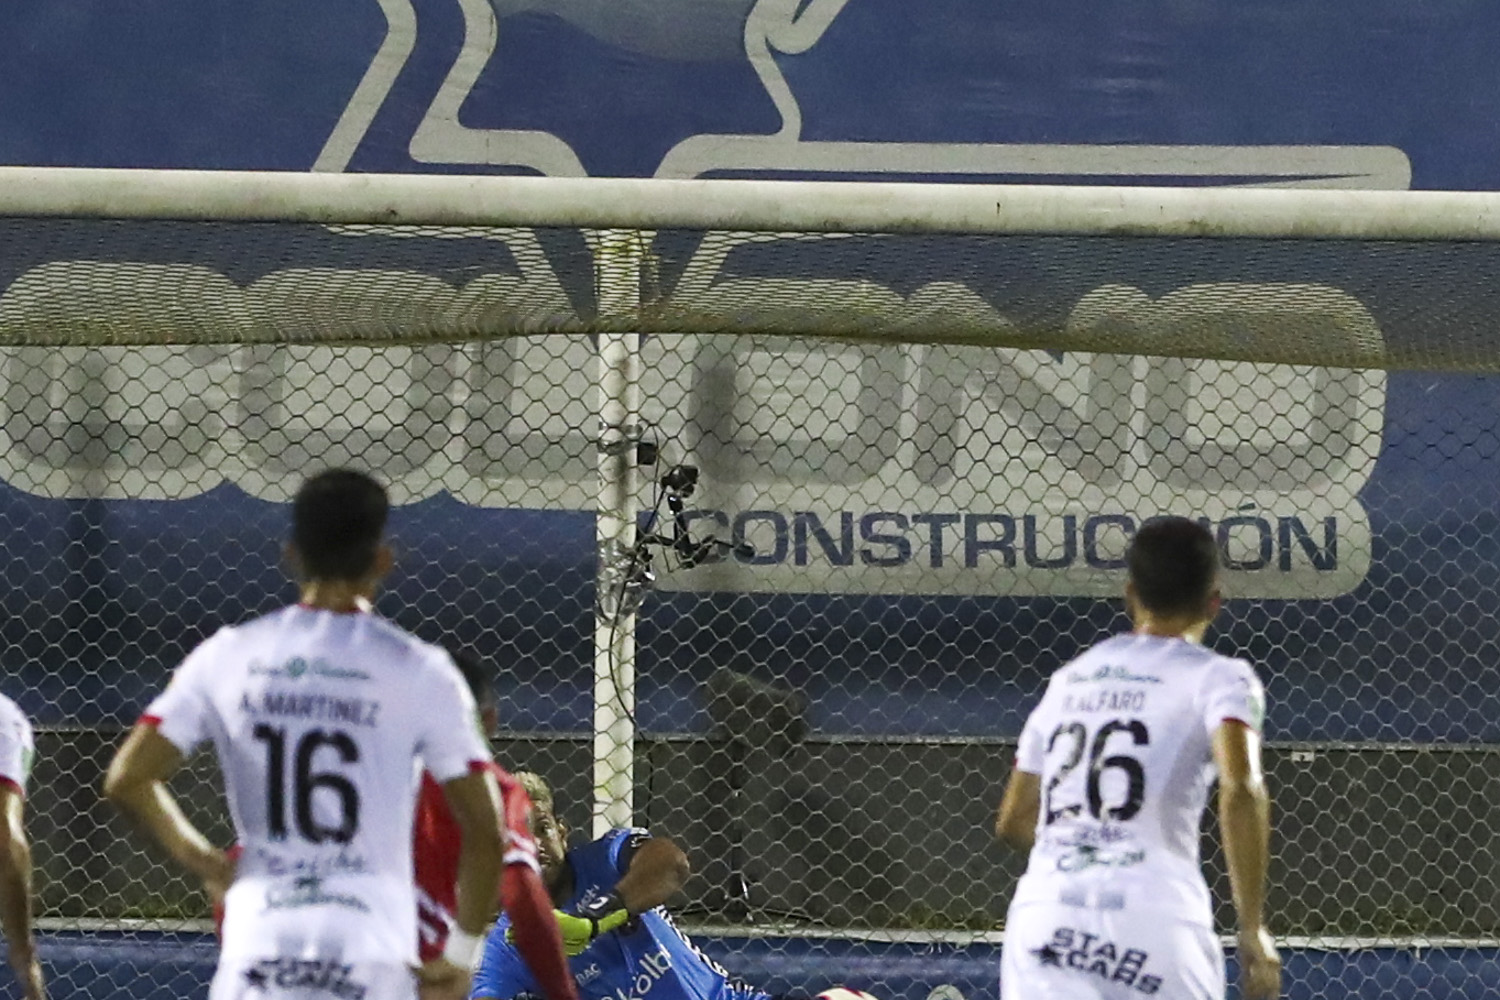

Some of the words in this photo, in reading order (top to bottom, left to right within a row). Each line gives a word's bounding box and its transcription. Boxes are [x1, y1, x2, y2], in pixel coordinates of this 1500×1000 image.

[674, 503, 1338, 573] CONSTRUCÓN
[252, 721, 360, 844] 16
[1044, 719, 1150, 825] 26
